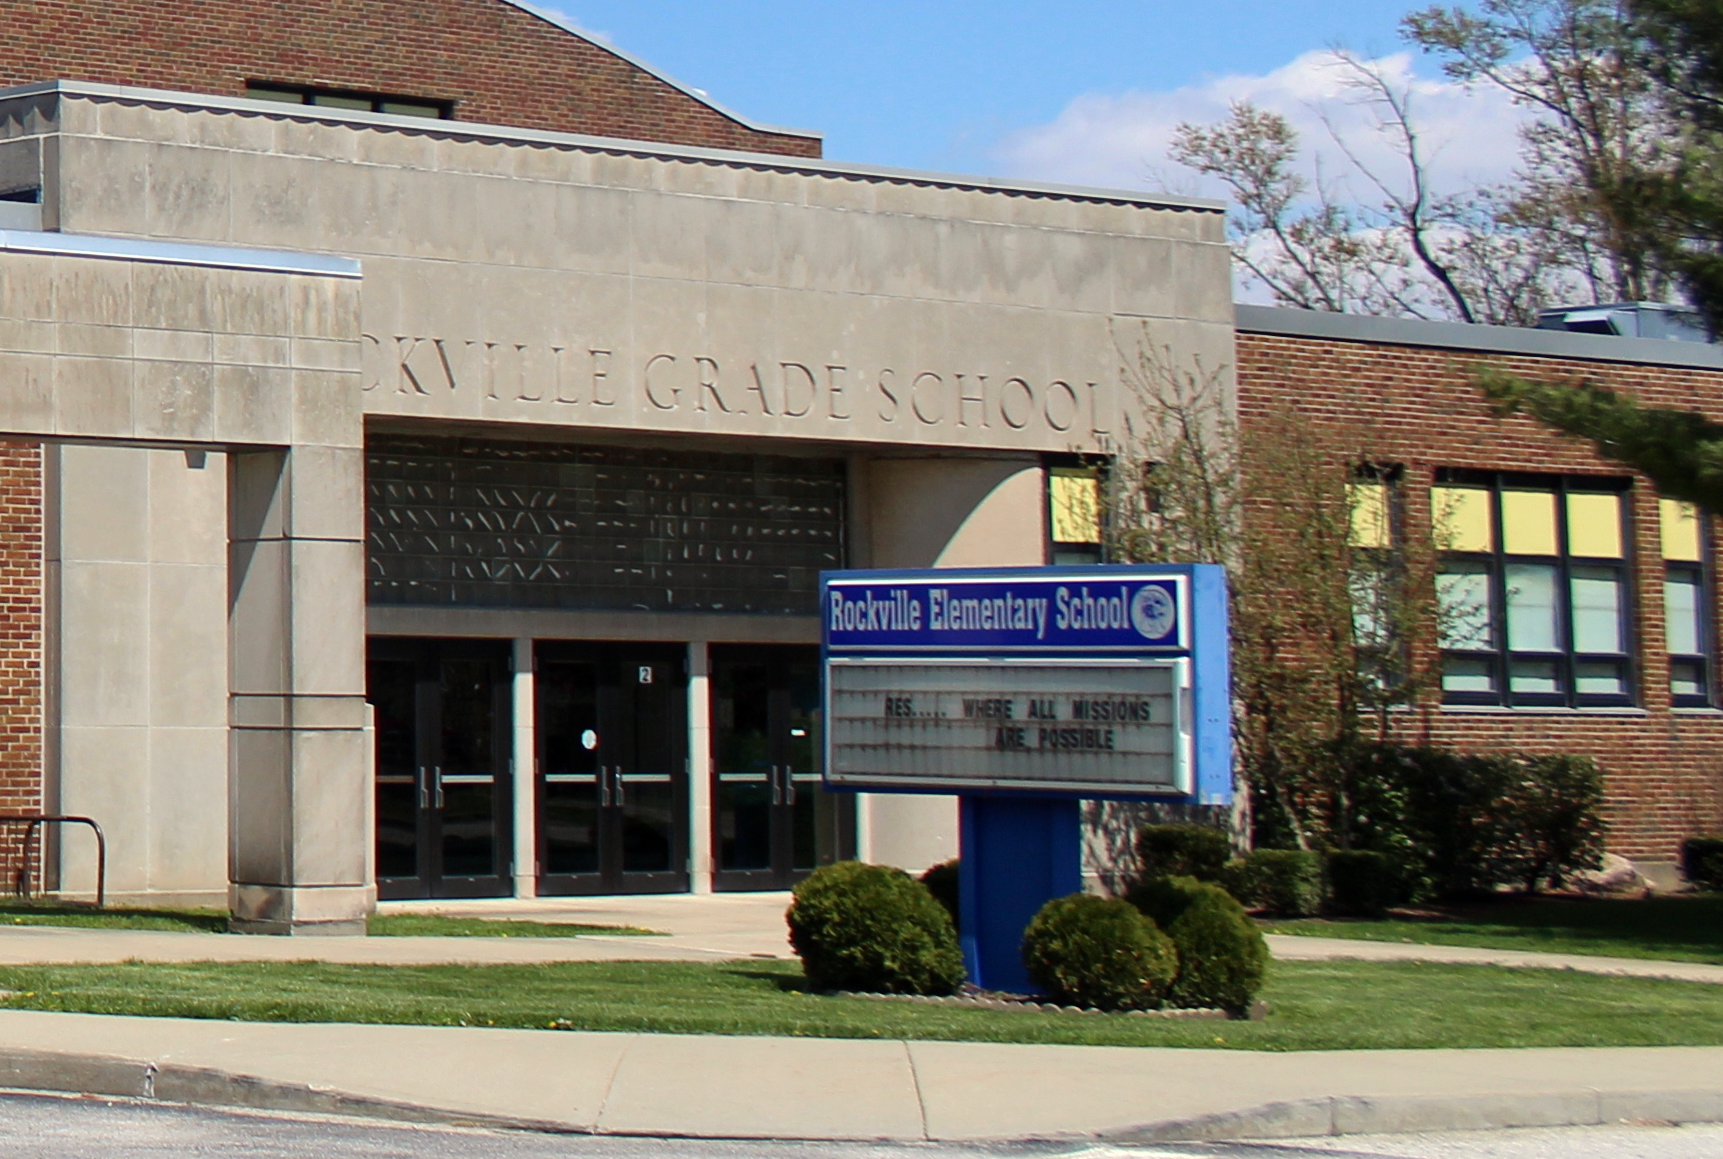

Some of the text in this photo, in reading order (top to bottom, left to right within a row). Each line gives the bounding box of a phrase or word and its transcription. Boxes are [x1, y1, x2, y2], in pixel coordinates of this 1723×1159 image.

[361, 333, 1110, 436] CKVILLE GRADE SCHOOL
[830, 586, 1129, 640] Rockville Elementary School
[641, 668, 649, 682] 2
[962, 698, 1013, 720] WHERE
[1027, 699, 1057, 721] ALL
[1072, 699, 1151, 722] MISSIONS
[994, 727, 1114, 751] ARE POSSIBLE
